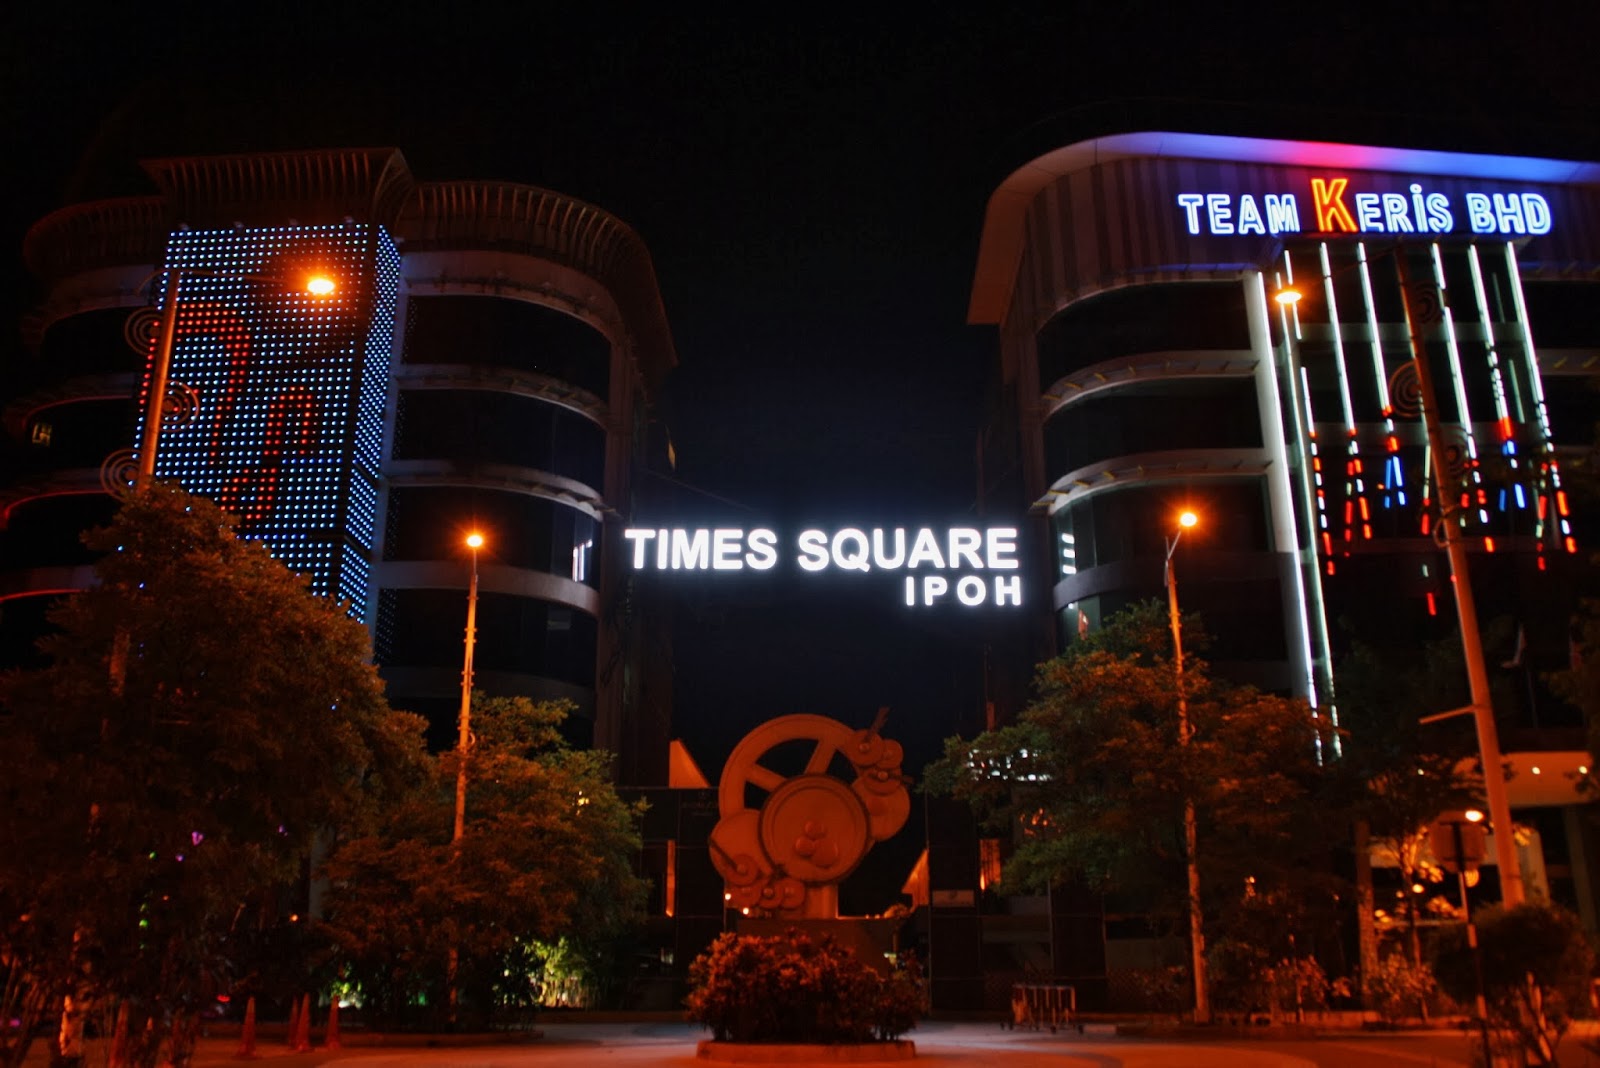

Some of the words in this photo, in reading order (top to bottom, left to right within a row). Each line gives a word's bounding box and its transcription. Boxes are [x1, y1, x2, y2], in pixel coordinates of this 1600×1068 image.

[1178, 193, 1300, 235] TEAM
[1466, 192, 1552, 235] BHD
[625, 528, 777, 570] TIMES
[797, 528, 1019, 573] SQUARE
[905, 576, 1022, 606] IPOH
